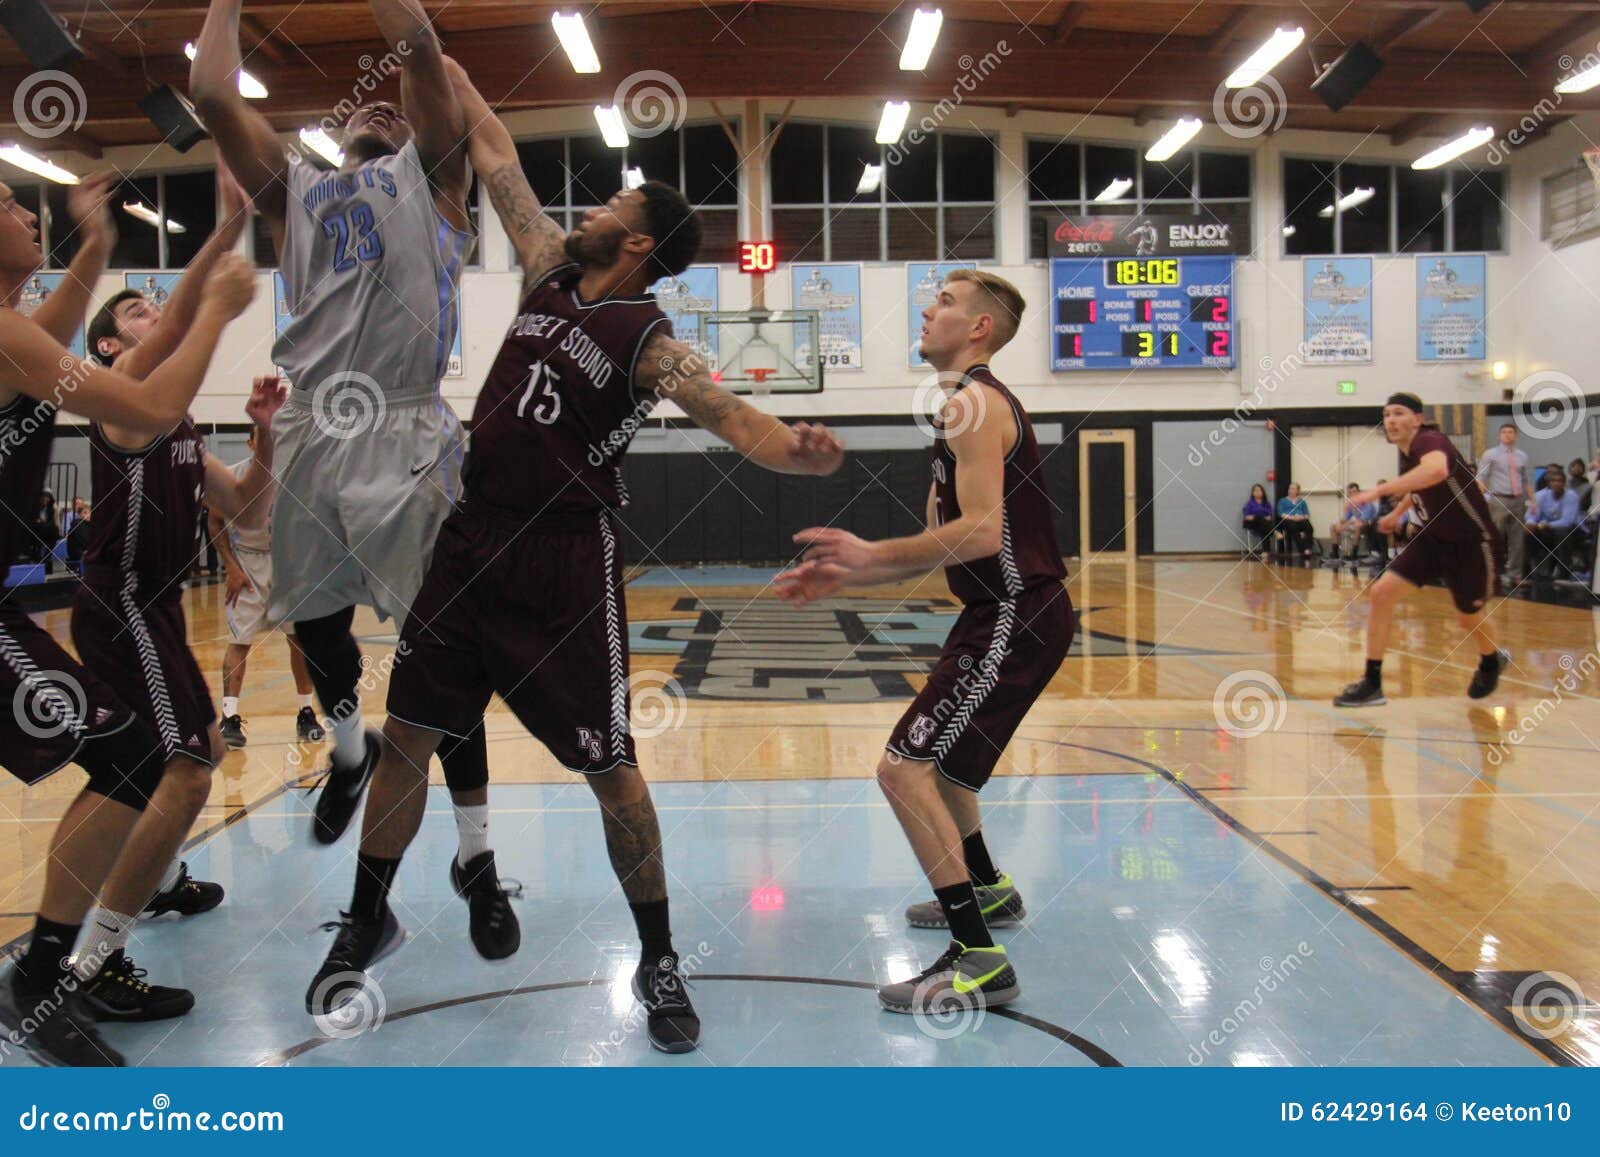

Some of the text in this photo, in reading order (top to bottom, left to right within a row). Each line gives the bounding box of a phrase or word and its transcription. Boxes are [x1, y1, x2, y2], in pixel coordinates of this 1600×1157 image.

[322, 202, 383, 273] 23
[1169, 224, 1229, 240] ENJOY
[742, 243, 773, 270] 30
[1116, 259, 1178, 285] 18:06
[1057, 287, 1095, 298] HOME
[1126, 290, 1159, 298] PERIOD
[1186, 285, 1230, 296] GUEST
[1104, 300, 1135, 309] BONUS
[1152, 300, 1181, 308] BONUS
[1212, 297, 1228, 322] 2
[1088, 300, 1096, 323] 1
[1106, 312, 1130, 321] POSS
[1144, 299, 1152, 323] 1
[1155, 312, 1180, 321] POSS
[1054, 325, 1084, 333] FOULS
[1119, 324, 1152, 332] PLAYER
[1202, 323, 1230, 331] FOULS
[1073, 334, 1082, 356] 1
[1212, 330, 1229, 356] 2
[507, 312, 613, 390] PUGET SOUND
[1055, 359, 1085, 367] SCORE
[1131, 357, 1160, 366] MATCH
[516, 359, 561, 425] 15
